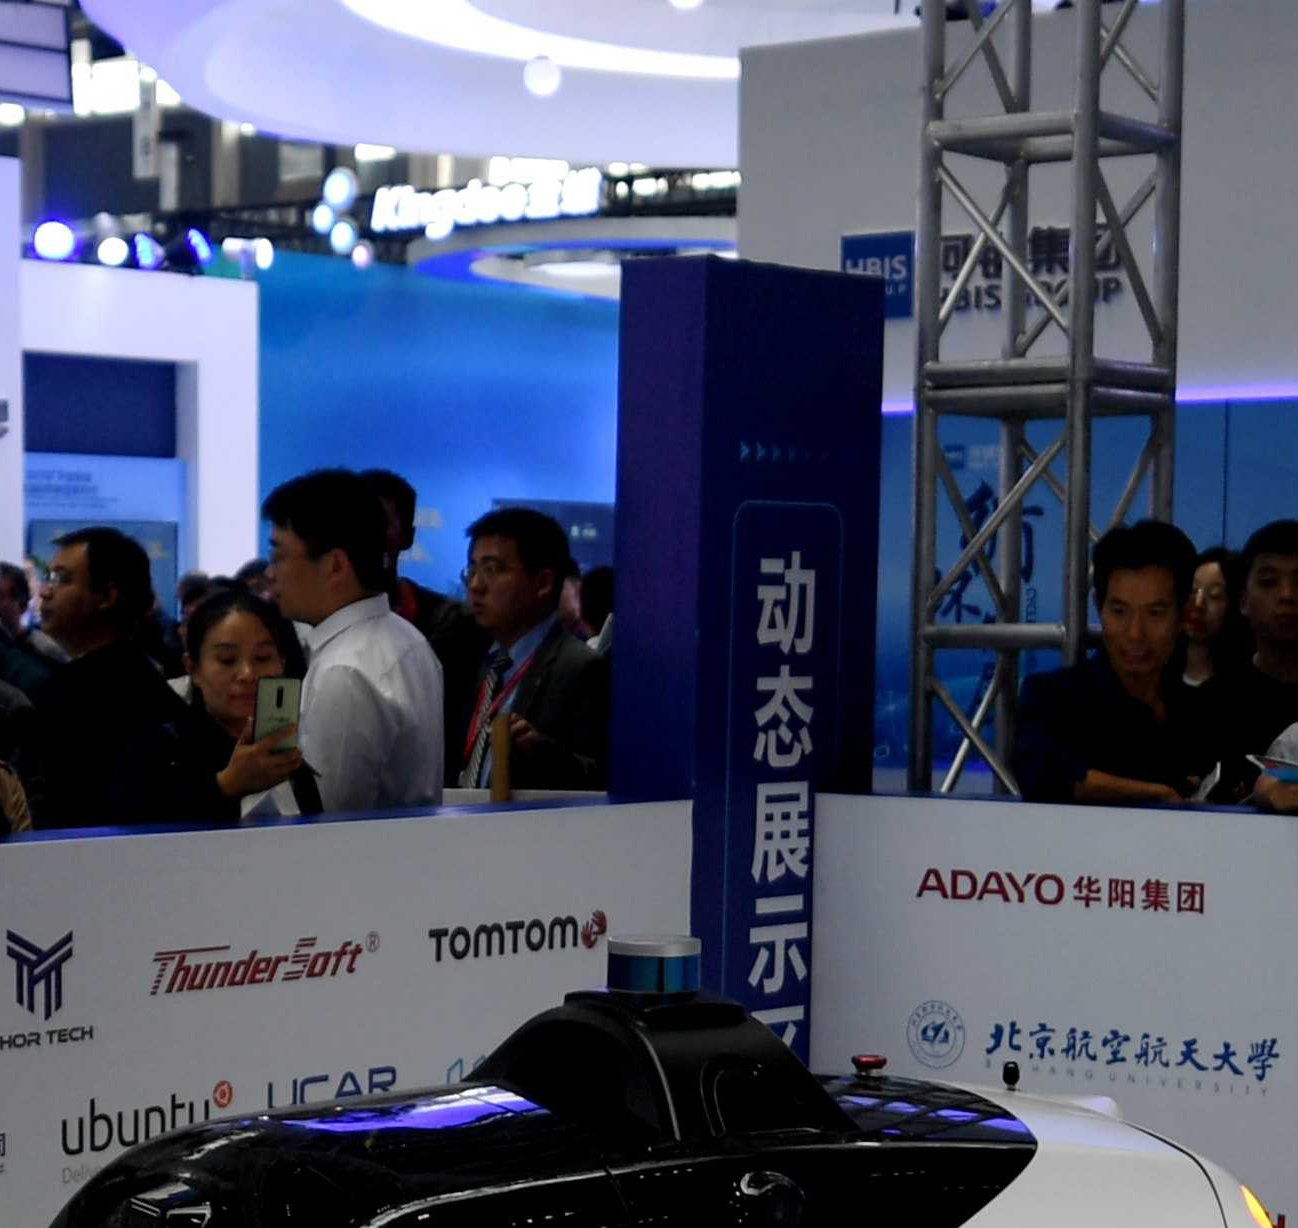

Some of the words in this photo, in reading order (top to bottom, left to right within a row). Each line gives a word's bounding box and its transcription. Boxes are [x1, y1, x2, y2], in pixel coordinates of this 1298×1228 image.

[915, 868, 1065, 907] ADAYO
[1072, 875, 1206, 915] 华阳集团
[149, 935, 363, 997] ThunderSoft
[46, 1025, 94, 1046] TECH
